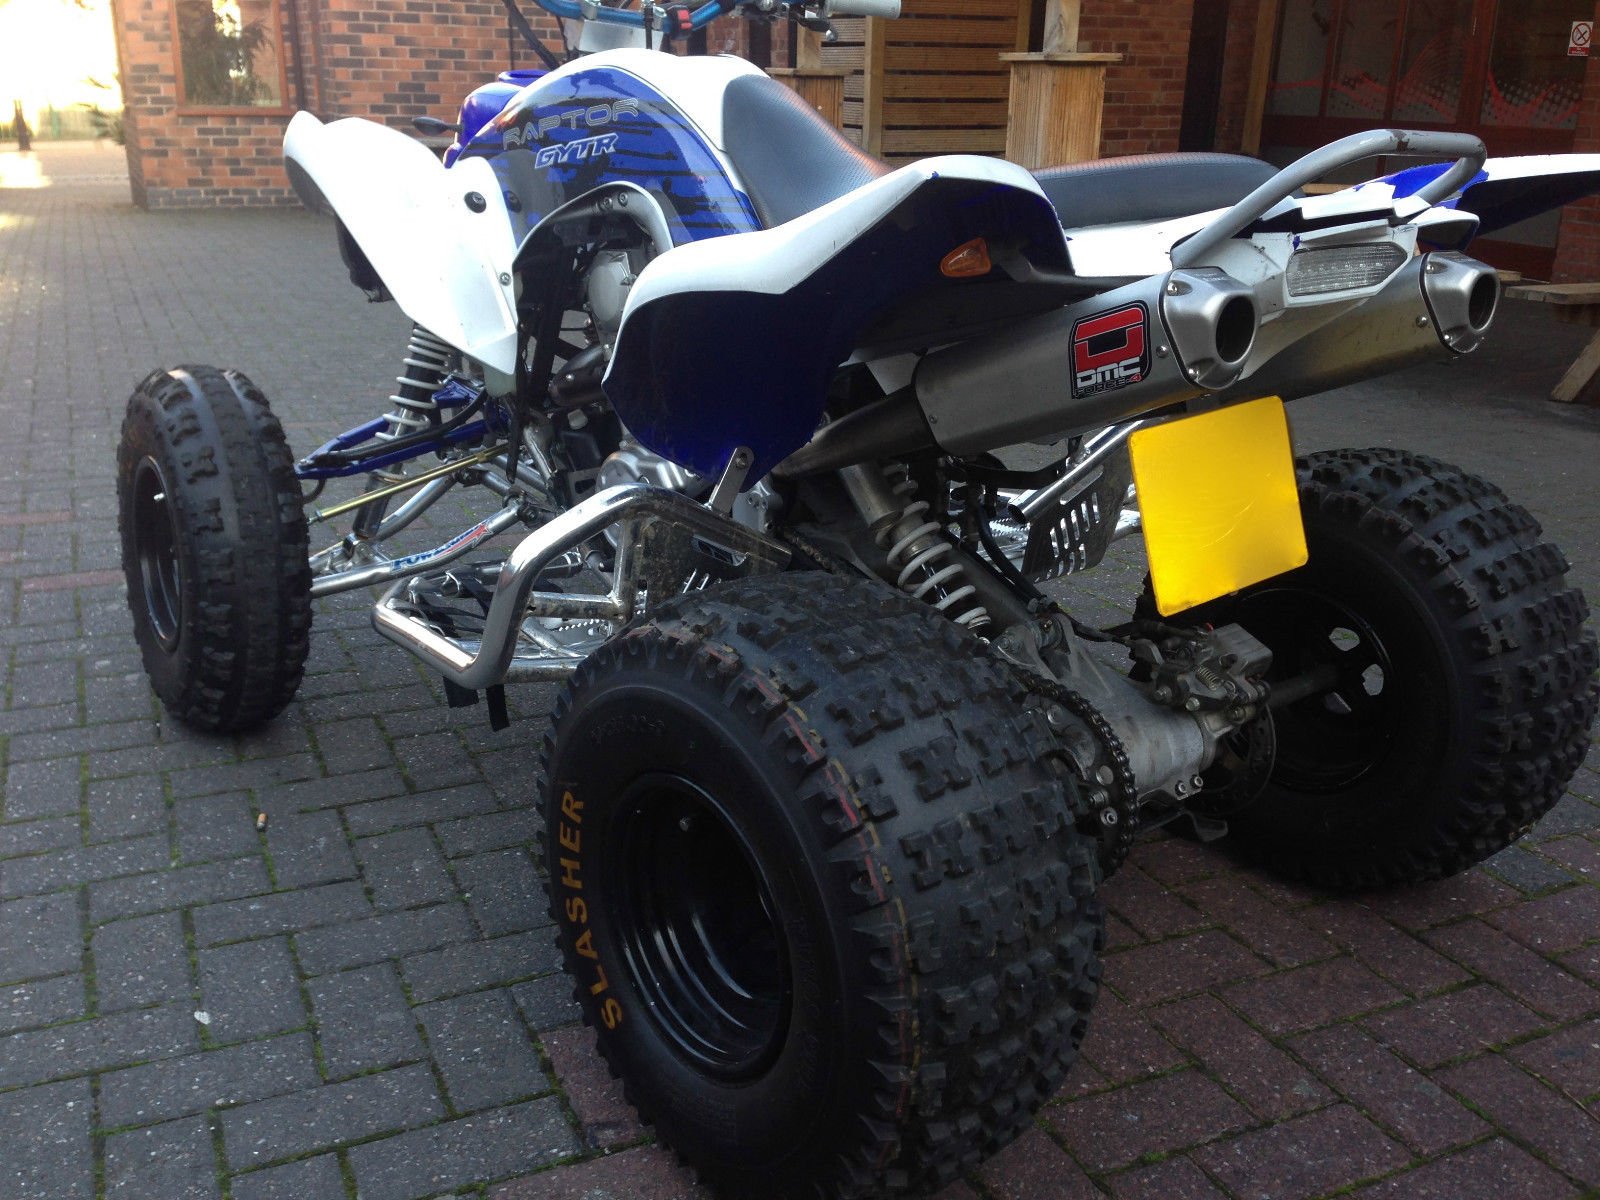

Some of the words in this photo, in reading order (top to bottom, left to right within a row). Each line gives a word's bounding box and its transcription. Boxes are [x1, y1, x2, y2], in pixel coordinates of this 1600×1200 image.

[502, 98, 639, 151] RAPTOR
[534, 132, 619, 169] GYTR
[1076, 356, 1141, 388] DMC
[559, 790, 623, 1030] SLASHER
